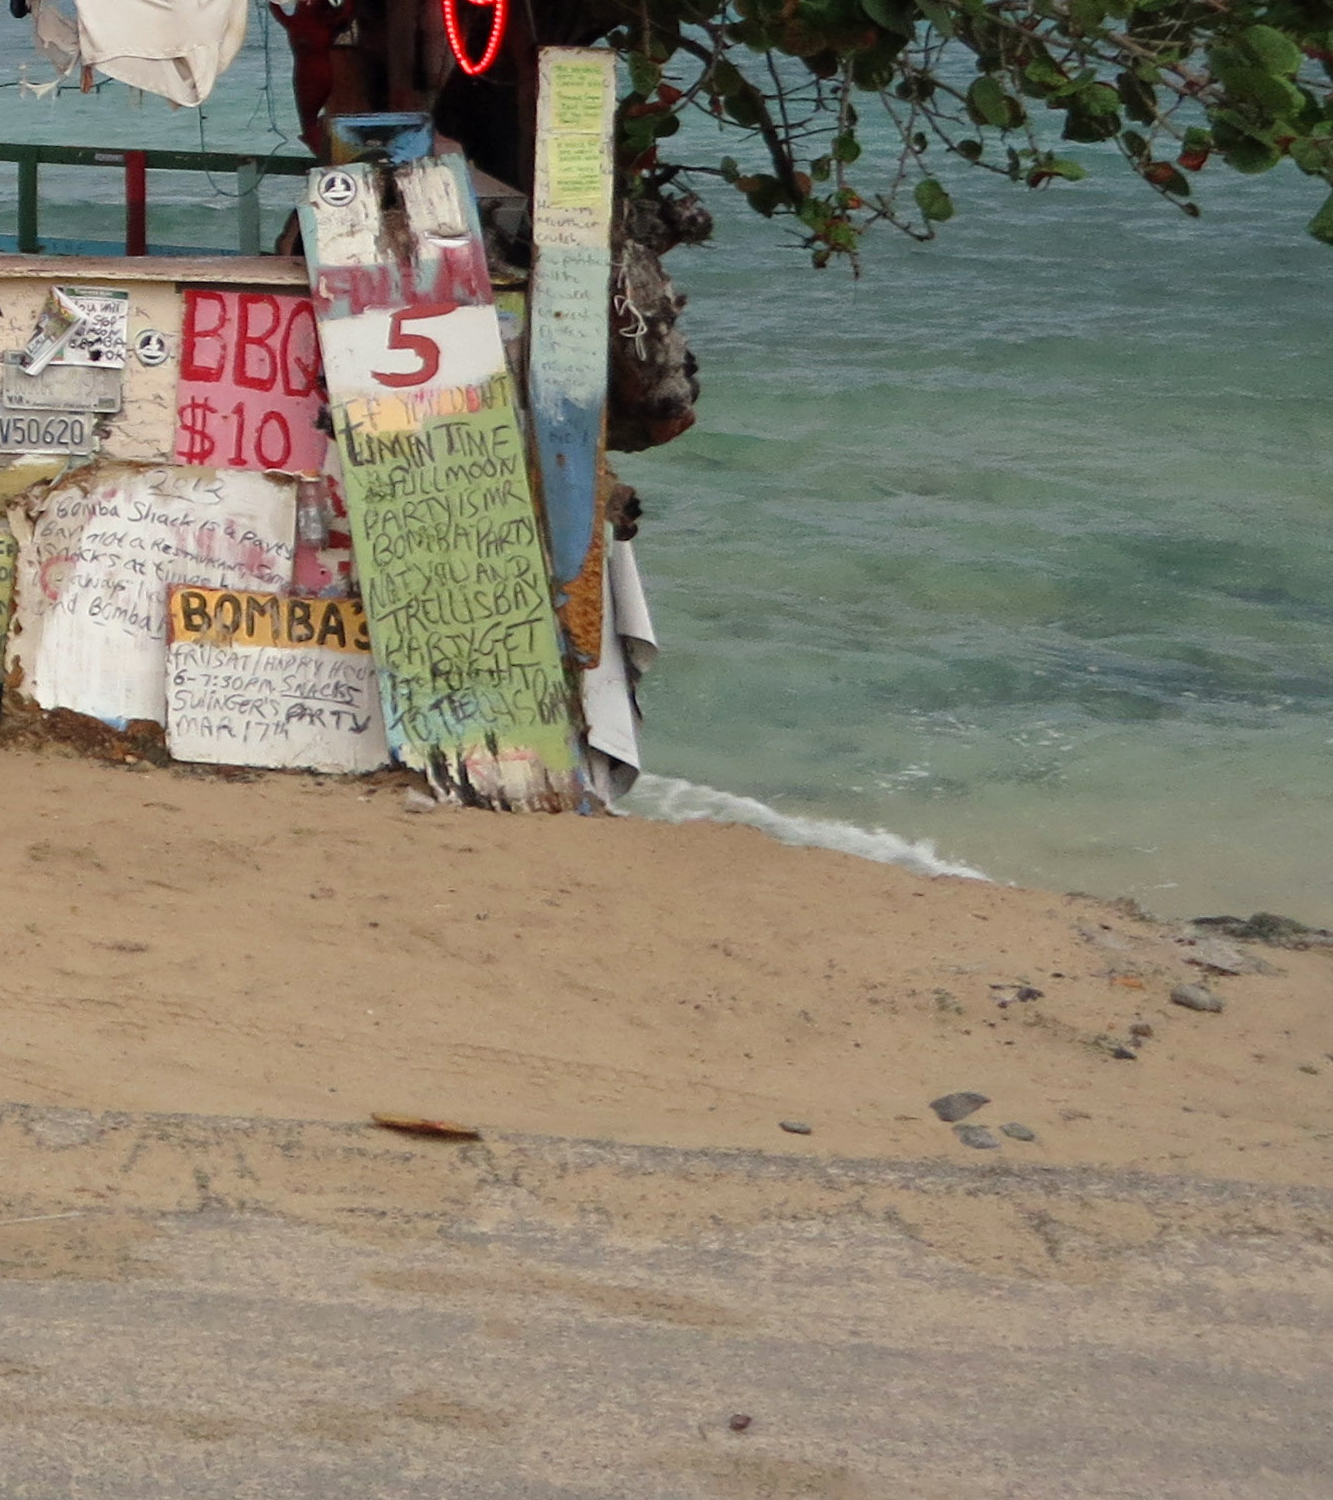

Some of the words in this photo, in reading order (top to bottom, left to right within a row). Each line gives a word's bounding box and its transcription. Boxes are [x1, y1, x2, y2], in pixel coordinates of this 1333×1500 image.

[181, 289, 330, 403] BBQ
[370, 301, 462, 388] 5
[177, 395, 293, 469] $10
[444, 453, 518, 486] MOON
[126, 501, 195, 528] Shack
[363, 495, 452, 541] PARTY
